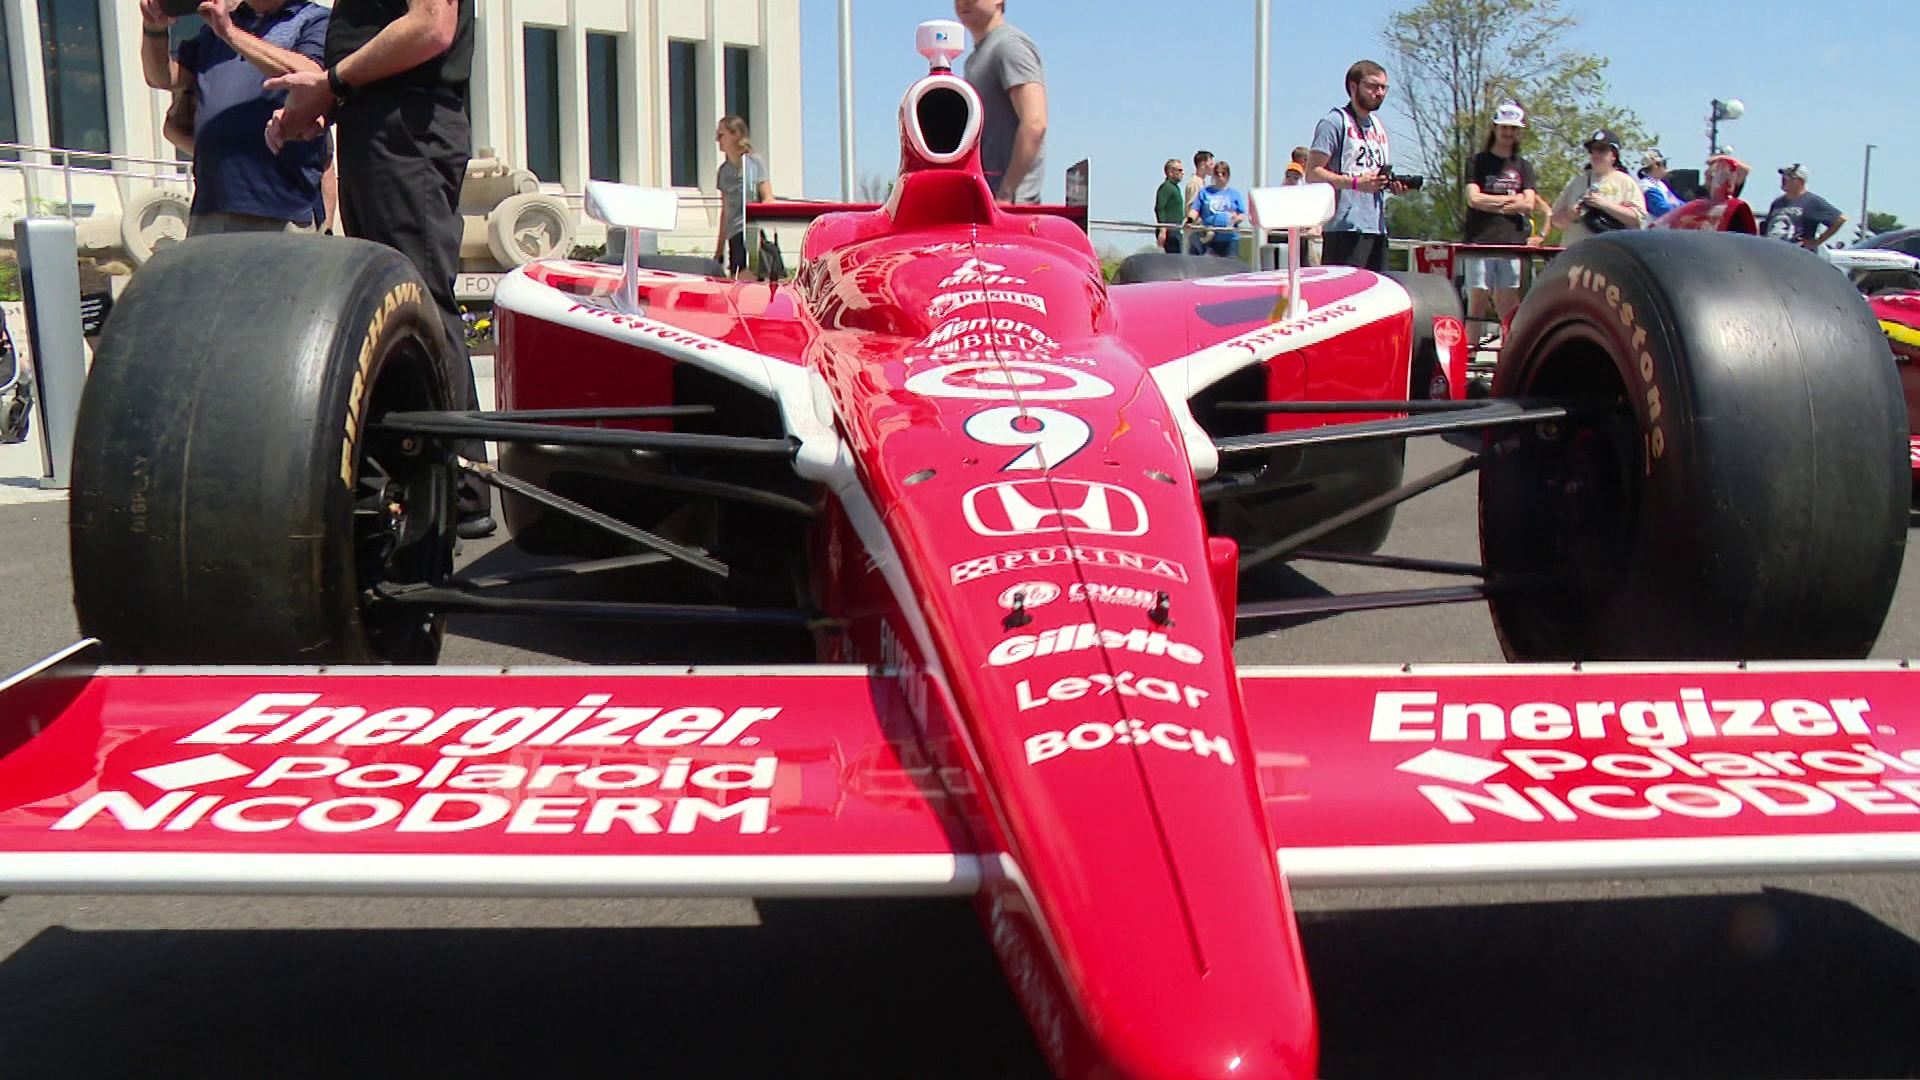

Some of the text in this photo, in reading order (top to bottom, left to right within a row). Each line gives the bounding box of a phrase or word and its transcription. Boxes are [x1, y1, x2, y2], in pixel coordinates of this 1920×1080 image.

[1568, 264, 1665, 458] Firestone
[340, 281, 423, 490] FIREHAWK
[962, 406, 1094, 473] 9
[1002, 546, 1179, 578] PURINA
[987, 622, 1205, 667] Gillette
[1015, 670, 1210, 712] Lexar
[174, 692, 784, 757] Energizer
[1369, 687, 1872, 748] Energizer
[1024, 718, 1236, 765] BOSCH
[246, 756, 779, 790] Polaroid
[48, 789, 772, 834] NICODERM
